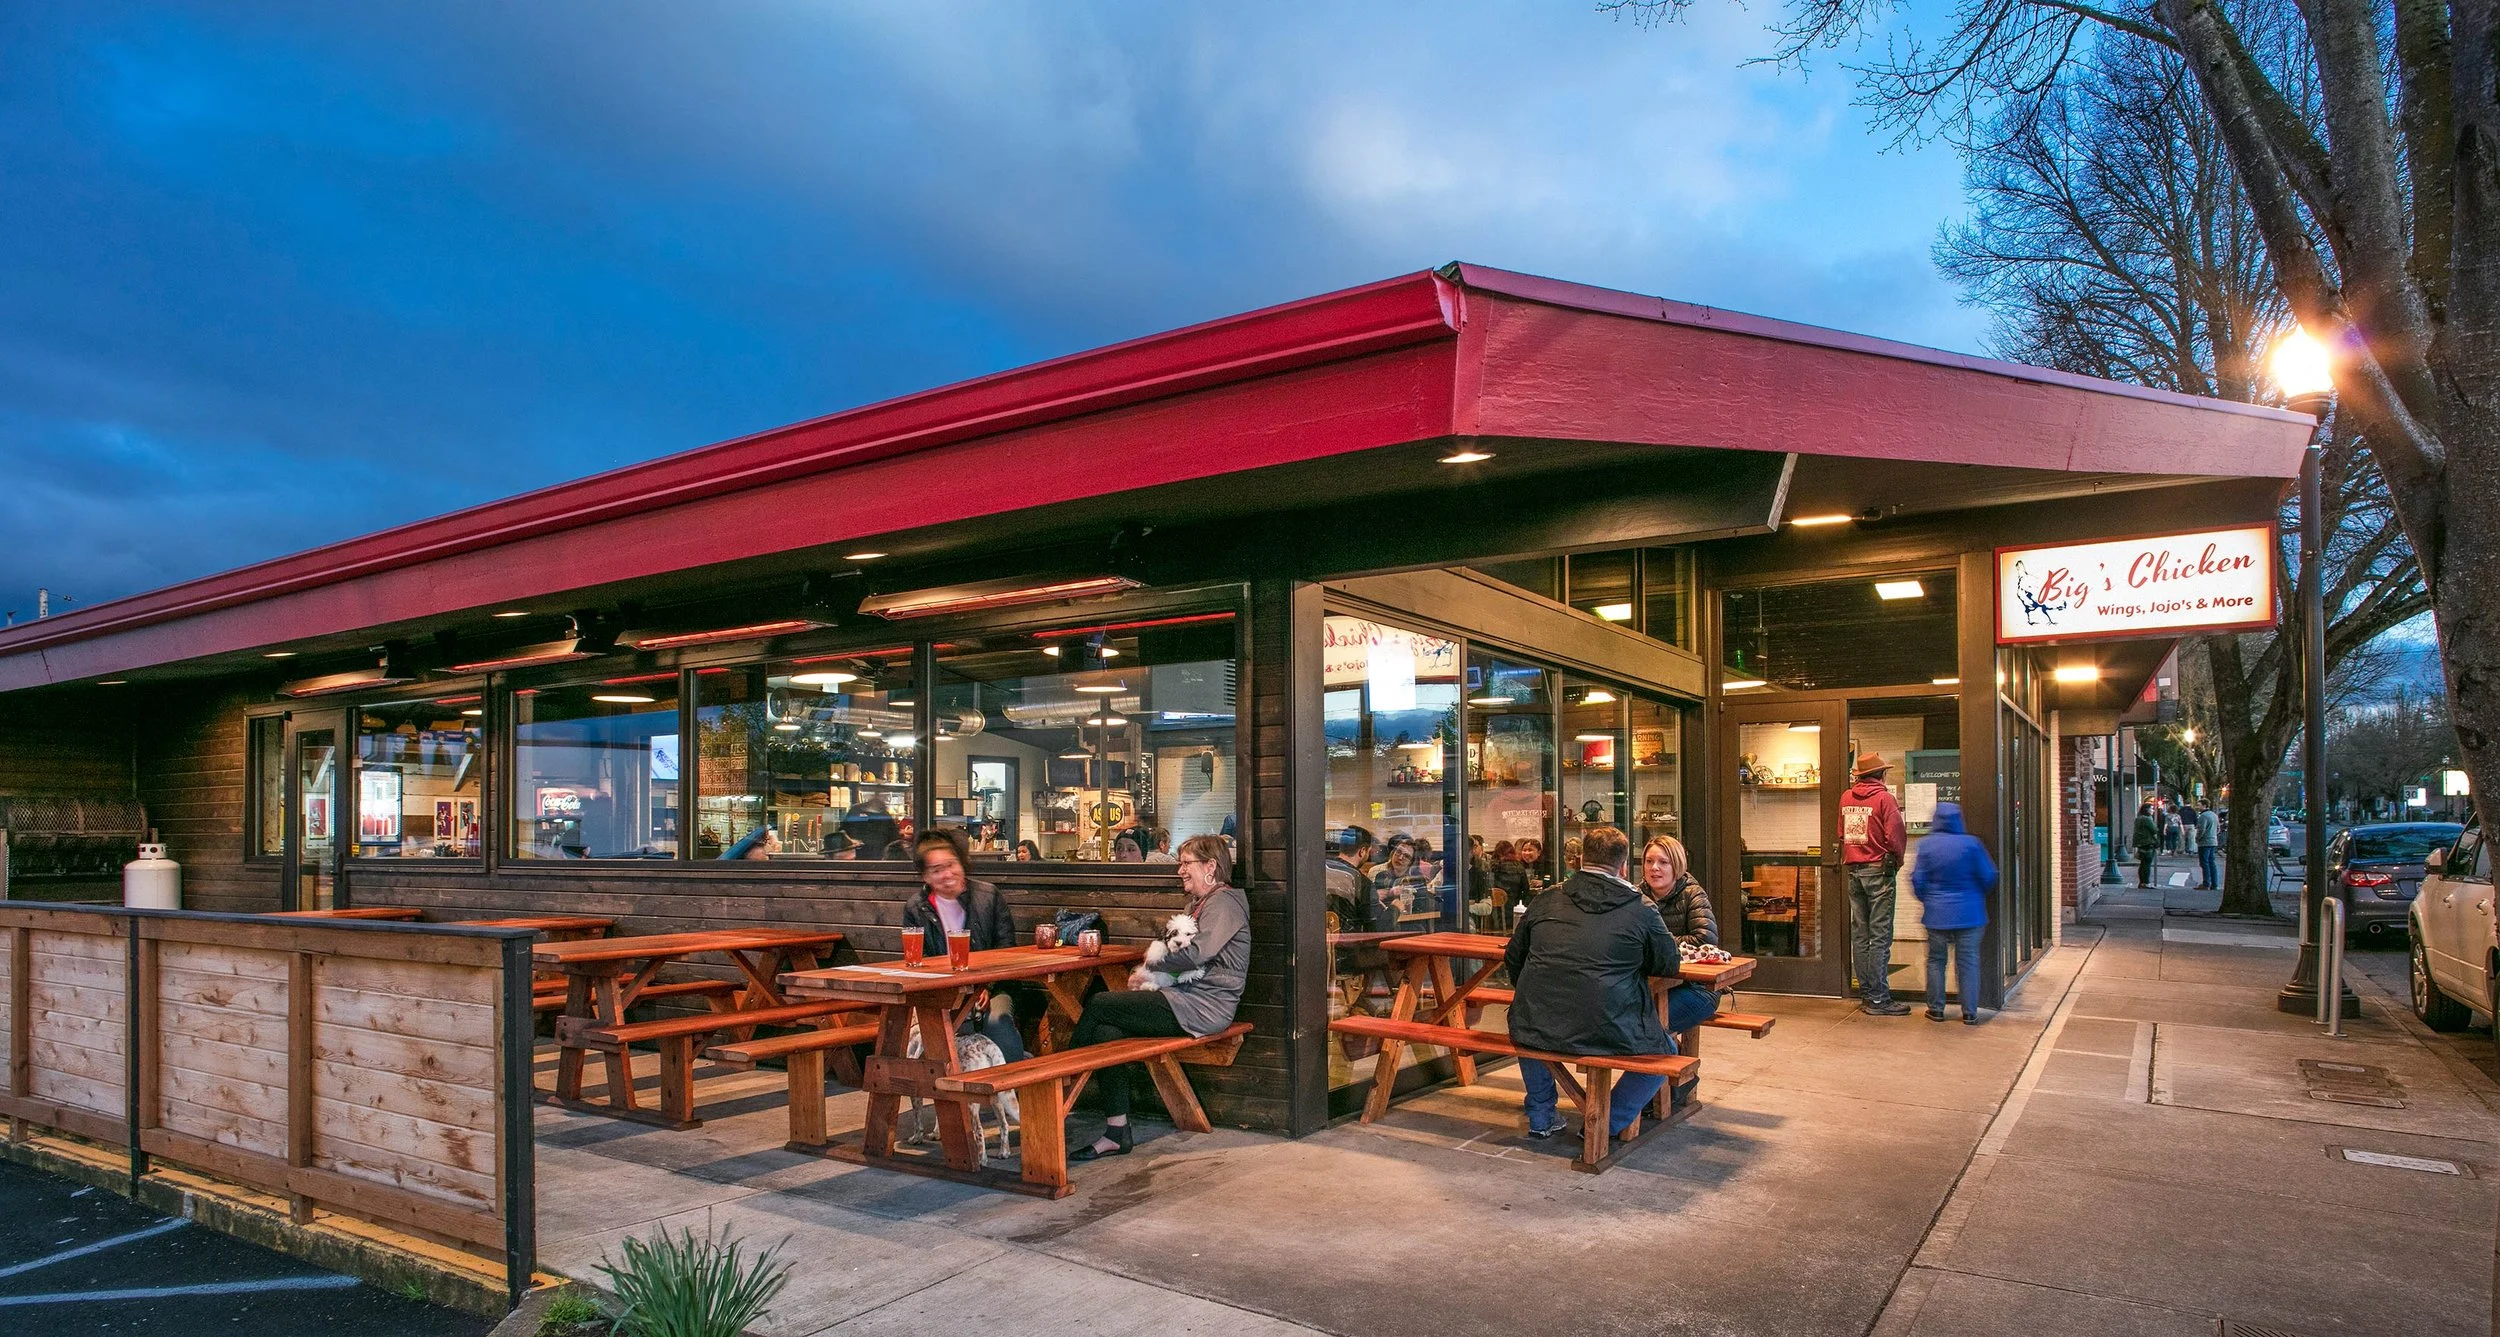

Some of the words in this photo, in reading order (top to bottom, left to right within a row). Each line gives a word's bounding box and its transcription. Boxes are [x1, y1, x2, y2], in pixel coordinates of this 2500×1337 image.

[2037, 562, 2112, 609] Big's
[2127, 542, 2256, 589] Chicken
[2097, 603, 2146, 618] Wings,
[2150, 599, 2192, 614] Jojo's
[2196, 598, 2208, 609] &
[2213, 596, 2254, 608] More
[1633, 734, 1660, 742] ARNING
[2405, 790, 2418, 799] 30
[1110, 807, 1121, 821] US
